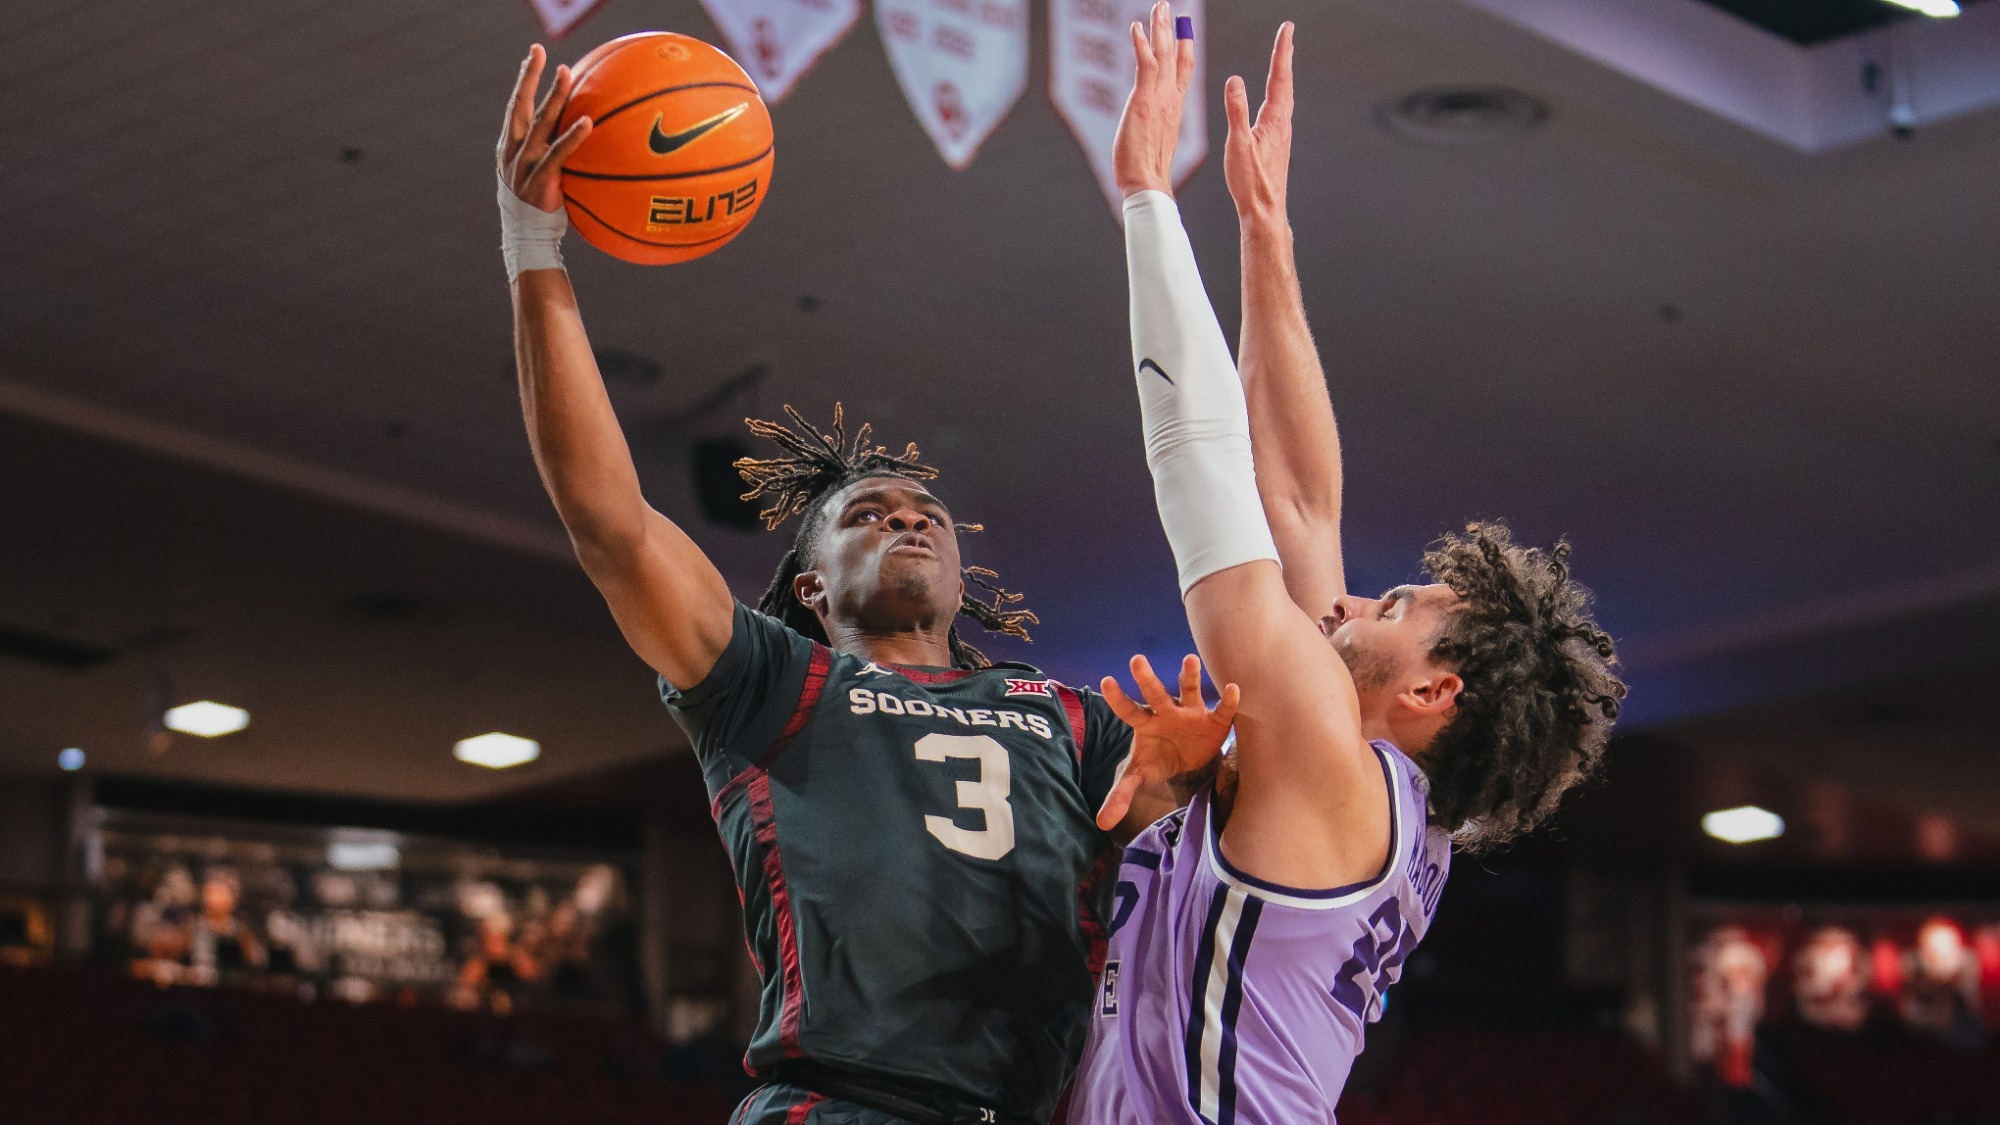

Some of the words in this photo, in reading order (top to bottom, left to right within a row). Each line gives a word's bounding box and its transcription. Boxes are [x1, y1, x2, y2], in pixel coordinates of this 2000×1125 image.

[649, 178, 758, 225] ELITE
[1007, 680, 1049, 696] XII
[849, 688, 1053, 740] SOONERS
[914, 732, 1015, 861] 3
